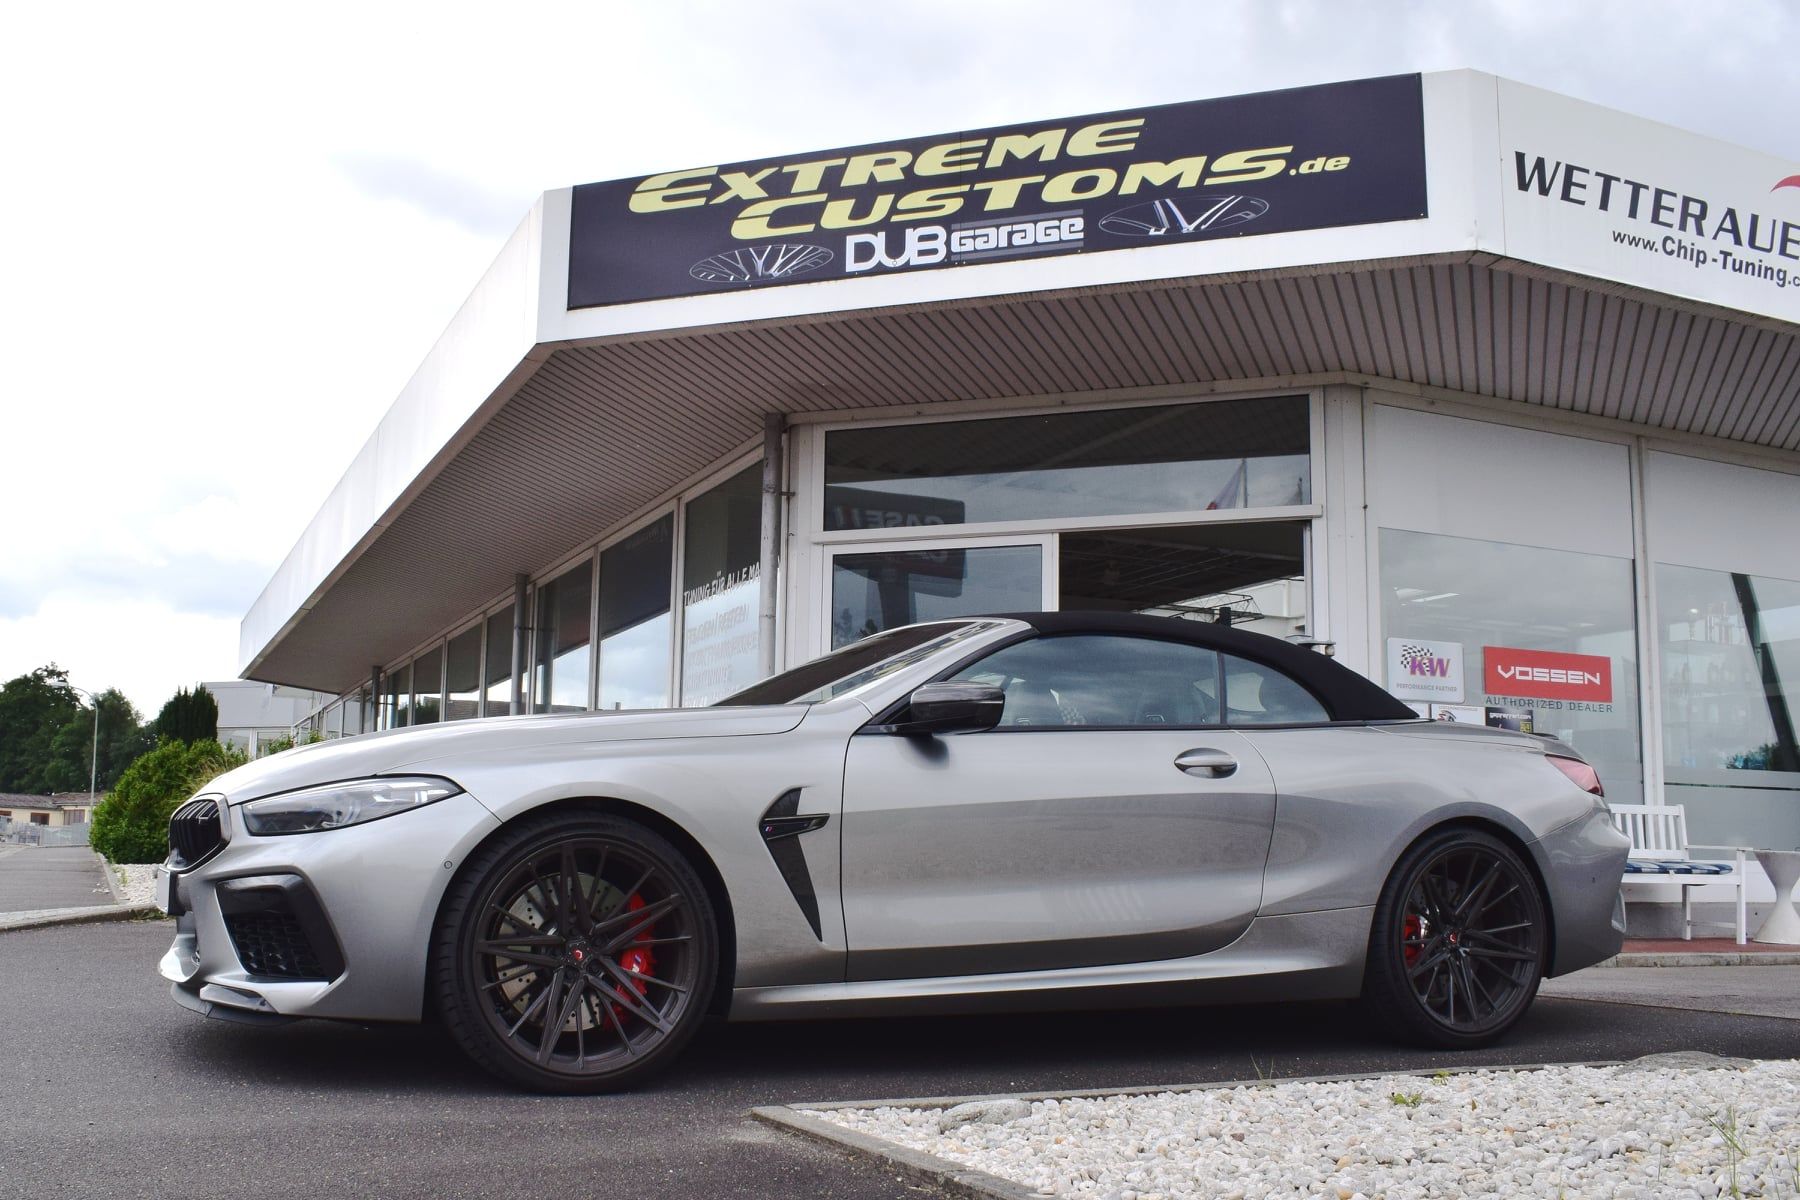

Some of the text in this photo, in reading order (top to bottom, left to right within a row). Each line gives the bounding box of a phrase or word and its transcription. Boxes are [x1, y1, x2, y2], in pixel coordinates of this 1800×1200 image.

[629, 118, 1146, 214] EXTREME
[731, 145, 1351, 240] CUSTOMS.de
[846, 225, 947, 272] DUB
[1410, 656, 1451, 678] KW
[1497, 664, 1601, 686] VOSSEN
[1485, 696, 1563, 710] AUTHORIZED
[1569, 701, 1614, 713] DEALER
